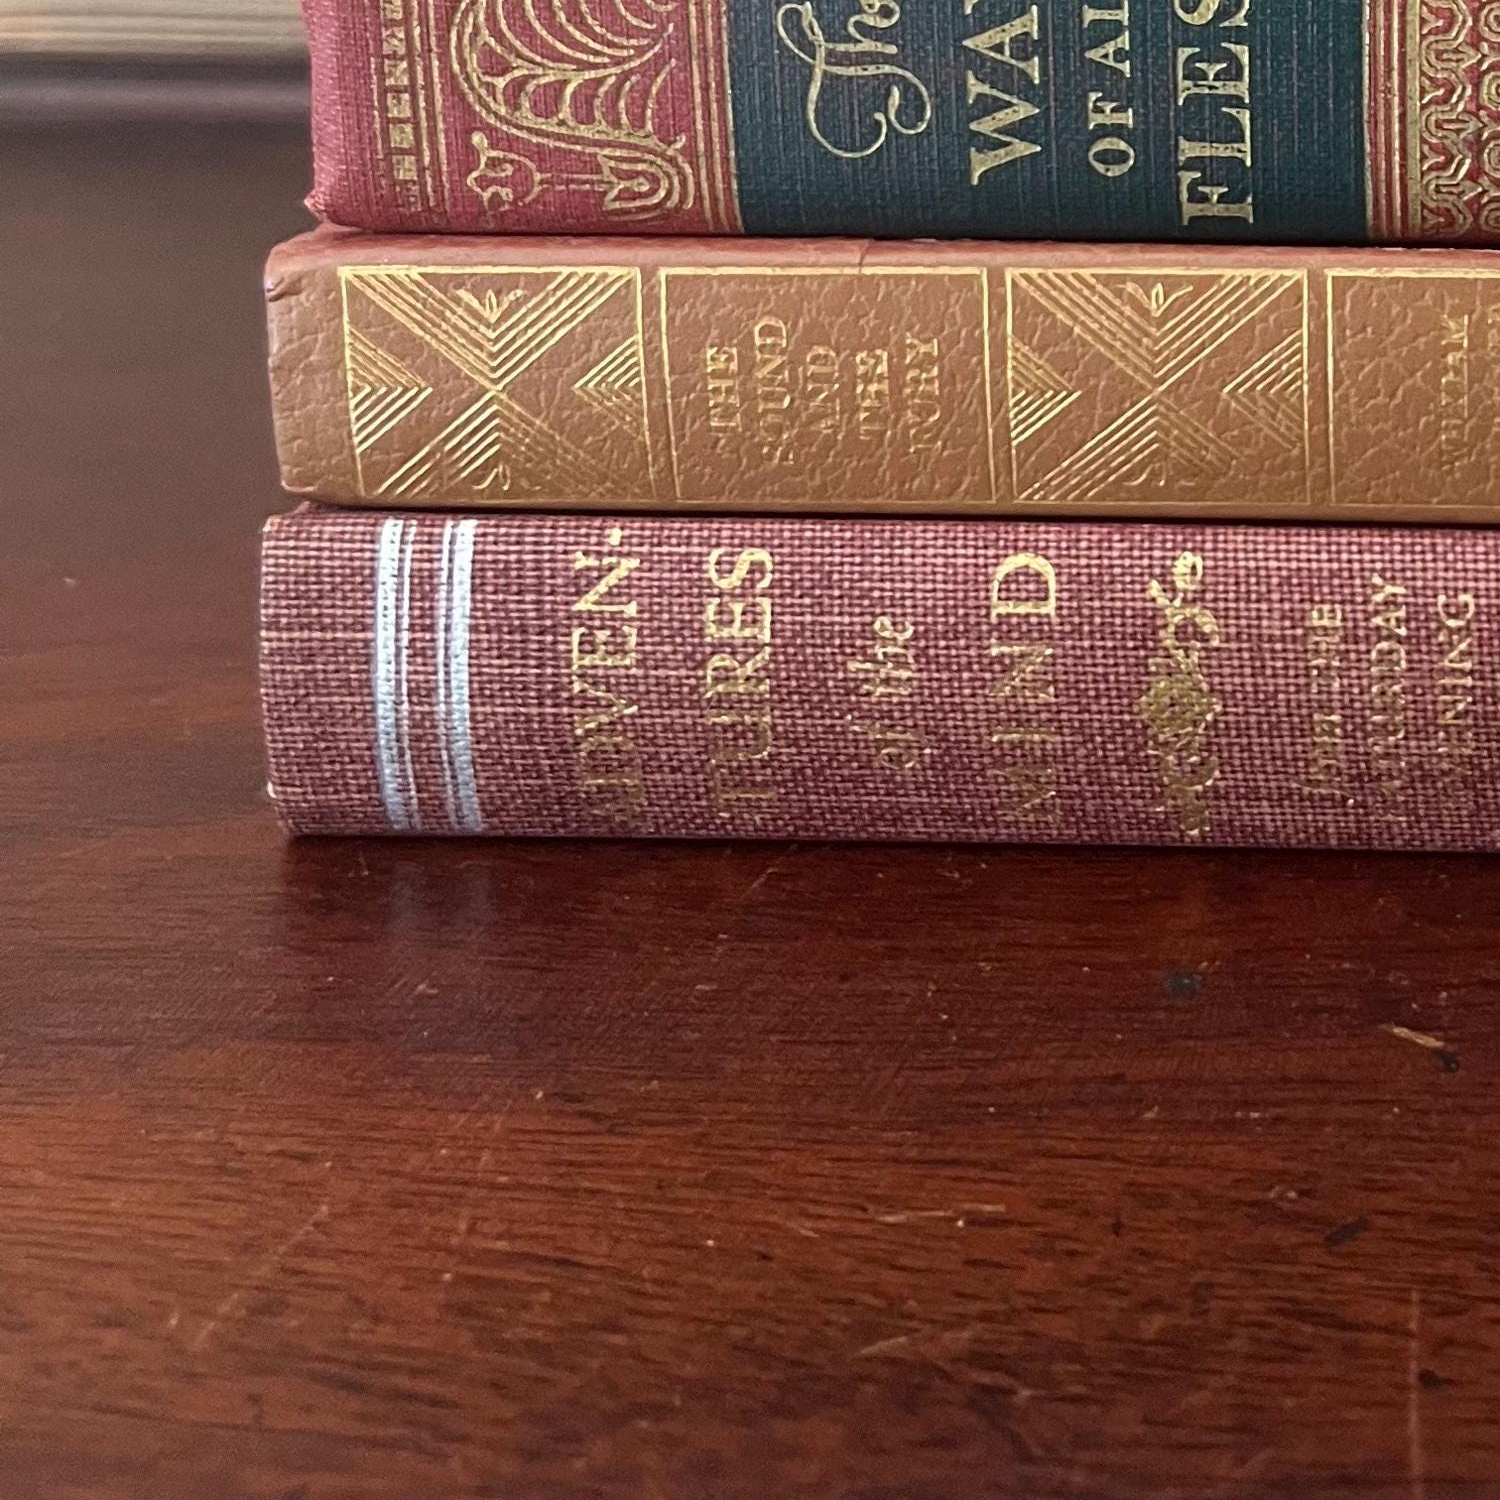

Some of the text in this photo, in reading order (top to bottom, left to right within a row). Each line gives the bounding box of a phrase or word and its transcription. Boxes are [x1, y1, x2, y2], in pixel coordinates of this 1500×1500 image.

[1088, 91, 1135, 177] OF
[706, 346, 741, 438] THE
[703, 547, 776, 806] TURES
